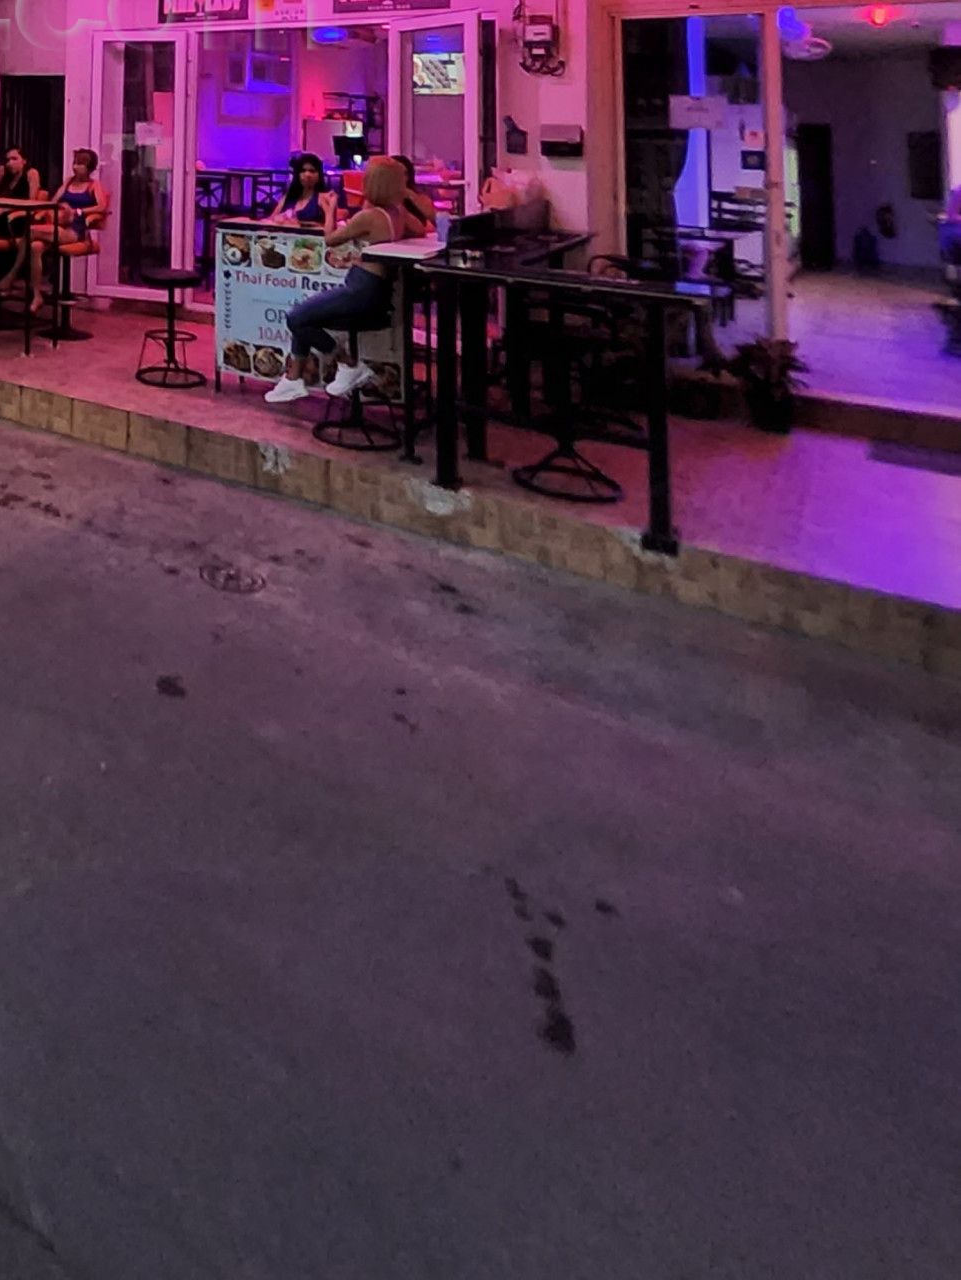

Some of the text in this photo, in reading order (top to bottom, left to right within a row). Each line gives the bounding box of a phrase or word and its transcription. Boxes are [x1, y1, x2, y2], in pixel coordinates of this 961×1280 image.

[234, 270, 262, 285] Thai
[265, 273, 298, 289] Food
[264, 308, 288, 324] OP
